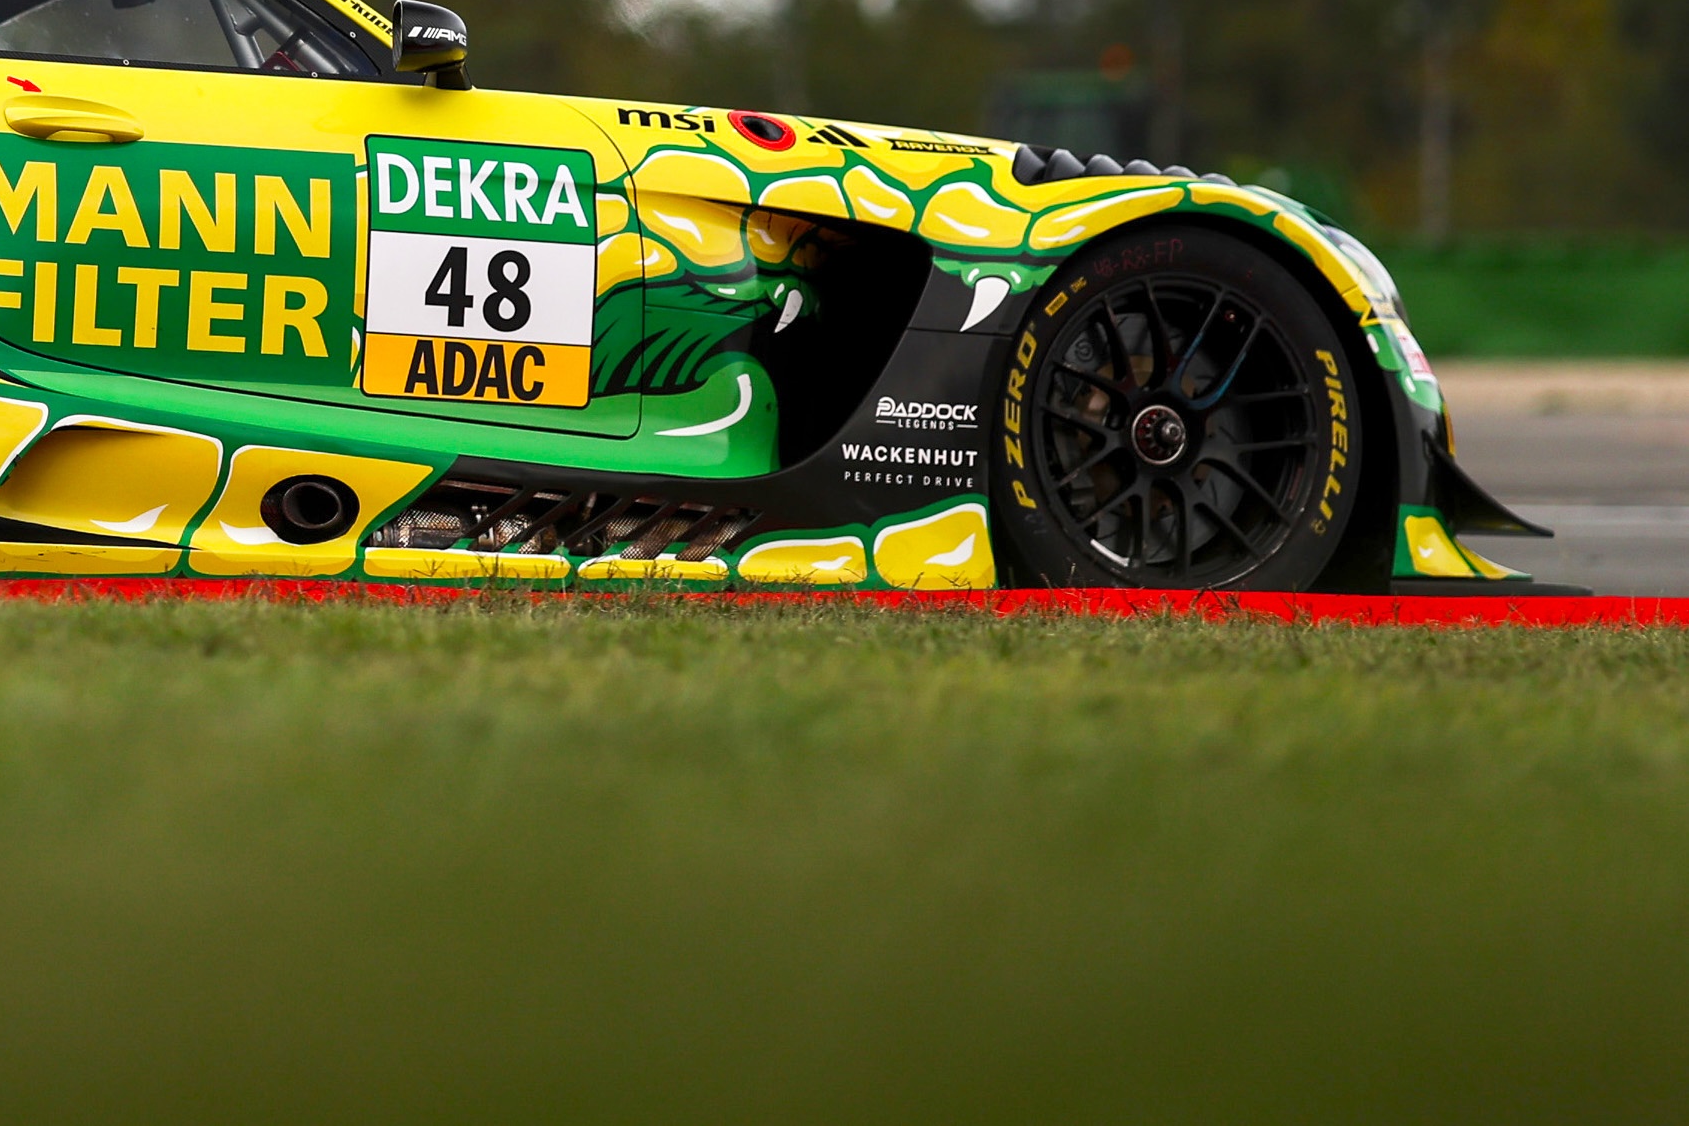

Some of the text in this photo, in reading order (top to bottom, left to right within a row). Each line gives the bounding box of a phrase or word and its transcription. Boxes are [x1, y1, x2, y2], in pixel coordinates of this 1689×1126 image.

[434, 27, 467, 46] AMG
[617, 108, 715, 133] msi
[894, 140, 988, 154] RAVENOL
[376, 152, 589, 229] DEKRA
[424, 245, 531, 332] 48
[404, 338, 546, 401] ADAC
[875, 396, 978, 421] PADDOCK
[1004, 330, 1038, 510] P ZERO
[897, 419, 955, 430] LEGENDS
[1315, 349, 1348, 521] PIRELLI
[841, 443, 978, 467] WACKENHUT
[844, 471, 974, 488] PERFECT DRIVE
